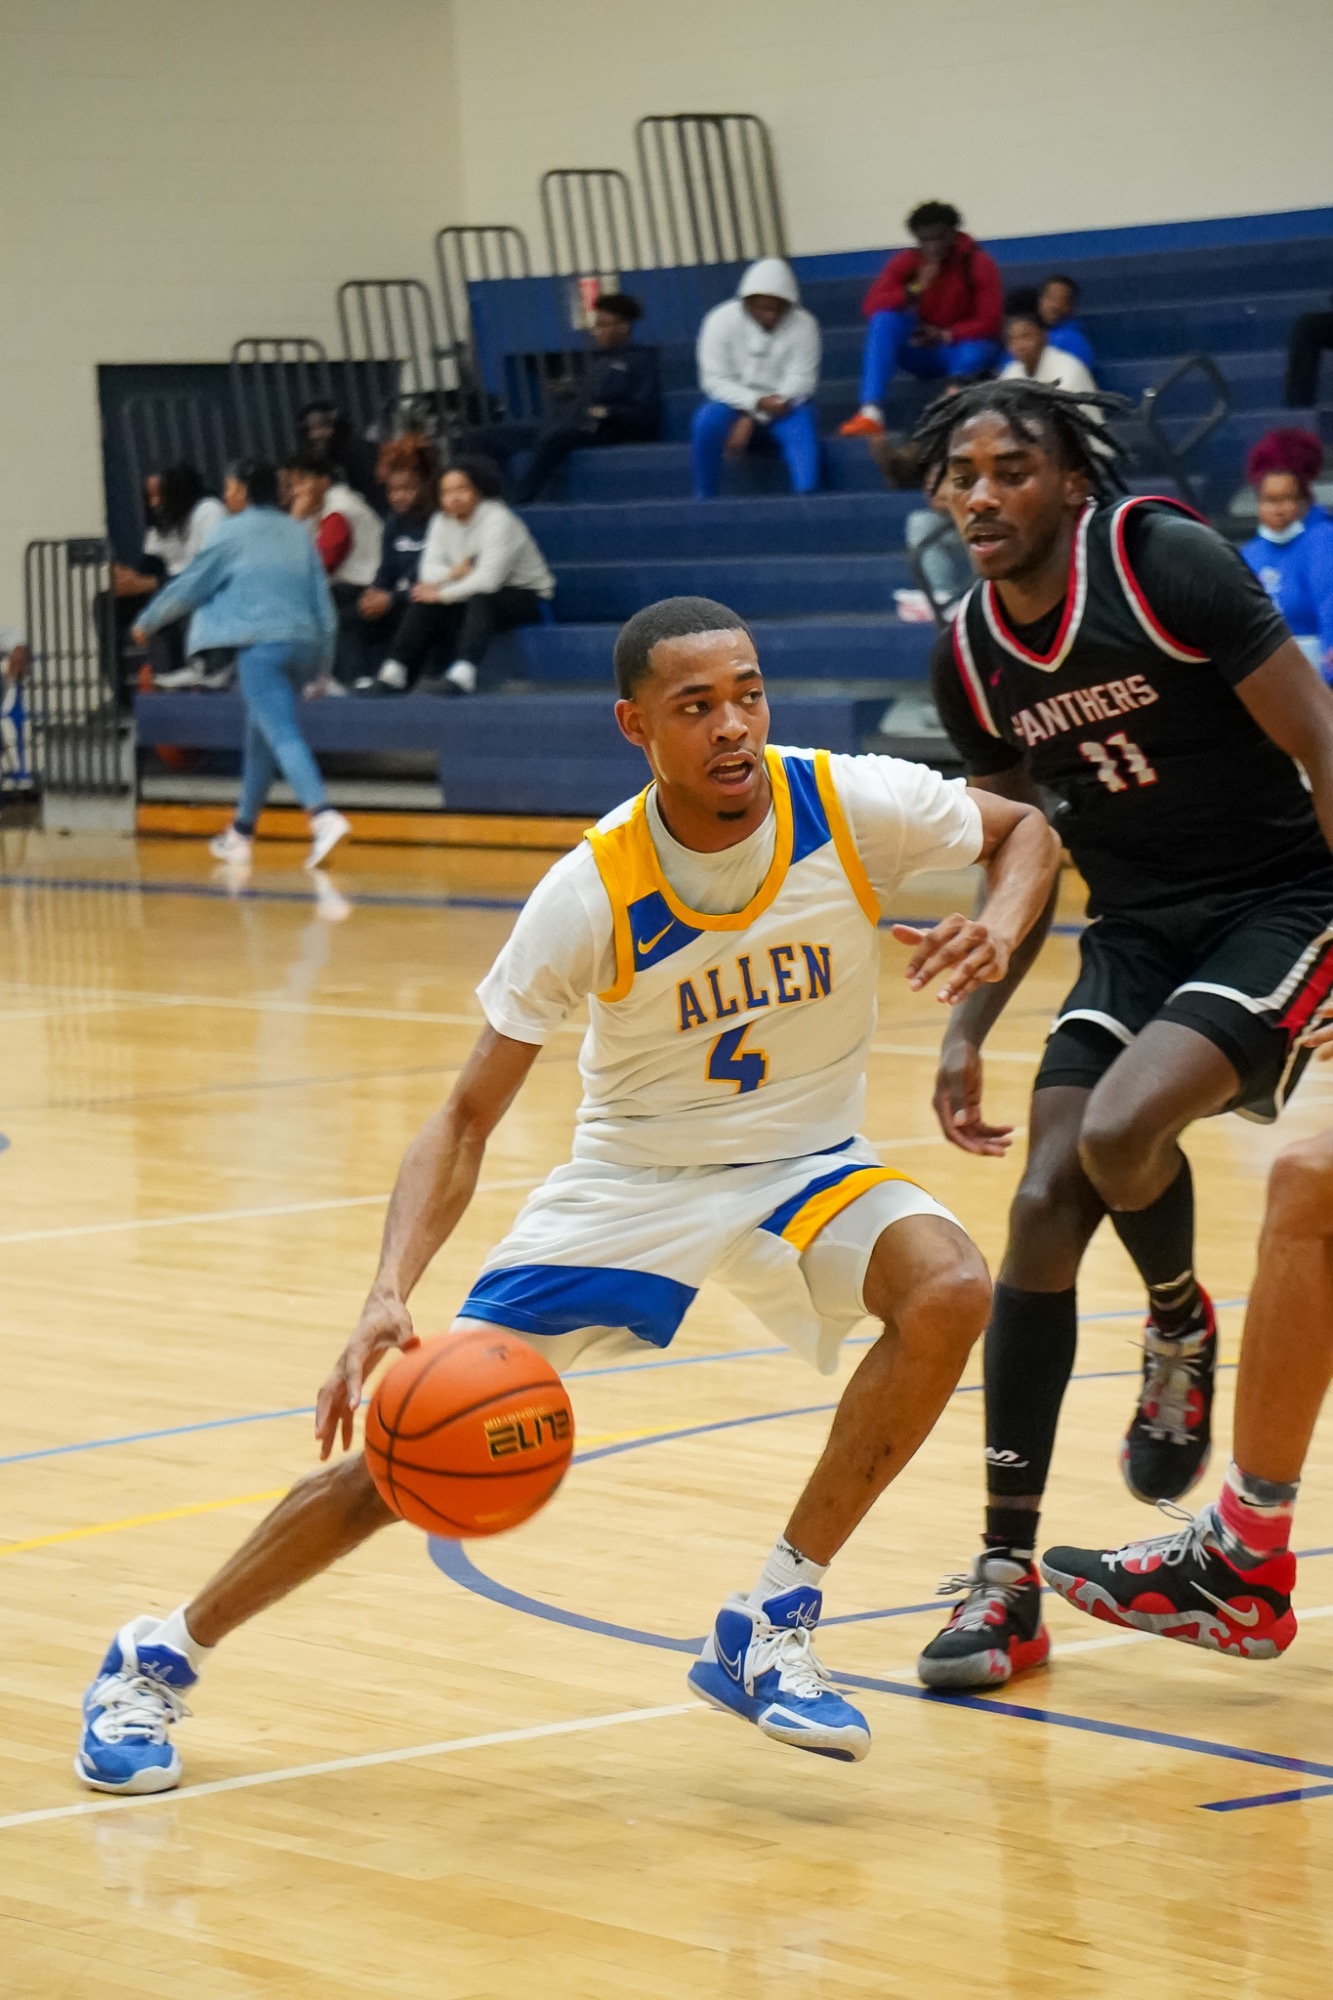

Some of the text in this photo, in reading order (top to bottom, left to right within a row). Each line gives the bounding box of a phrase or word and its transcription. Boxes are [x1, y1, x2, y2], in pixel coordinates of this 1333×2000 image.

[1078, 729, 1158, 793] 11
[676, 940, 833, 1034] ALLEN
[705, 1022, 769, 1095] 4
